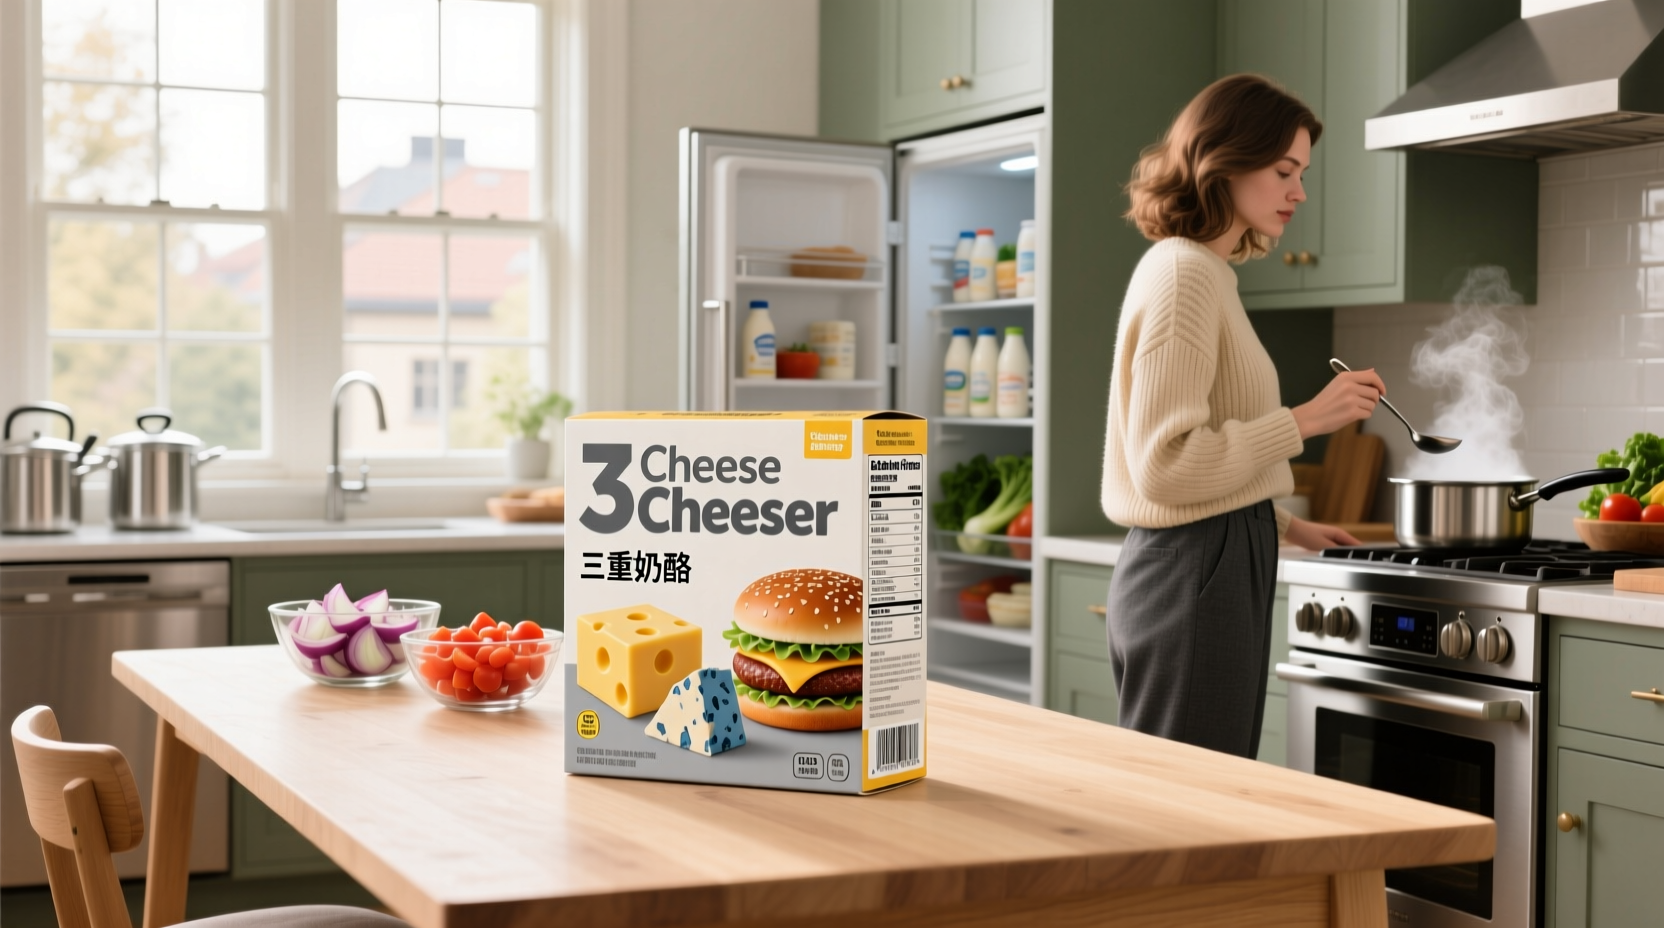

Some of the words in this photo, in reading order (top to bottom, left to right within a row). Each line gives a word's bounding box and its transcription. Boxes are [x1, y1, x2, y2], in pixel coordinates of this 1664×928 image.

[640, 444, 782, 485] Cheese
[578, 443, 635, 535] 3
[637, 486, 839, 537] Cheeser
[580, 549, 693, 585] 三重奶酪
